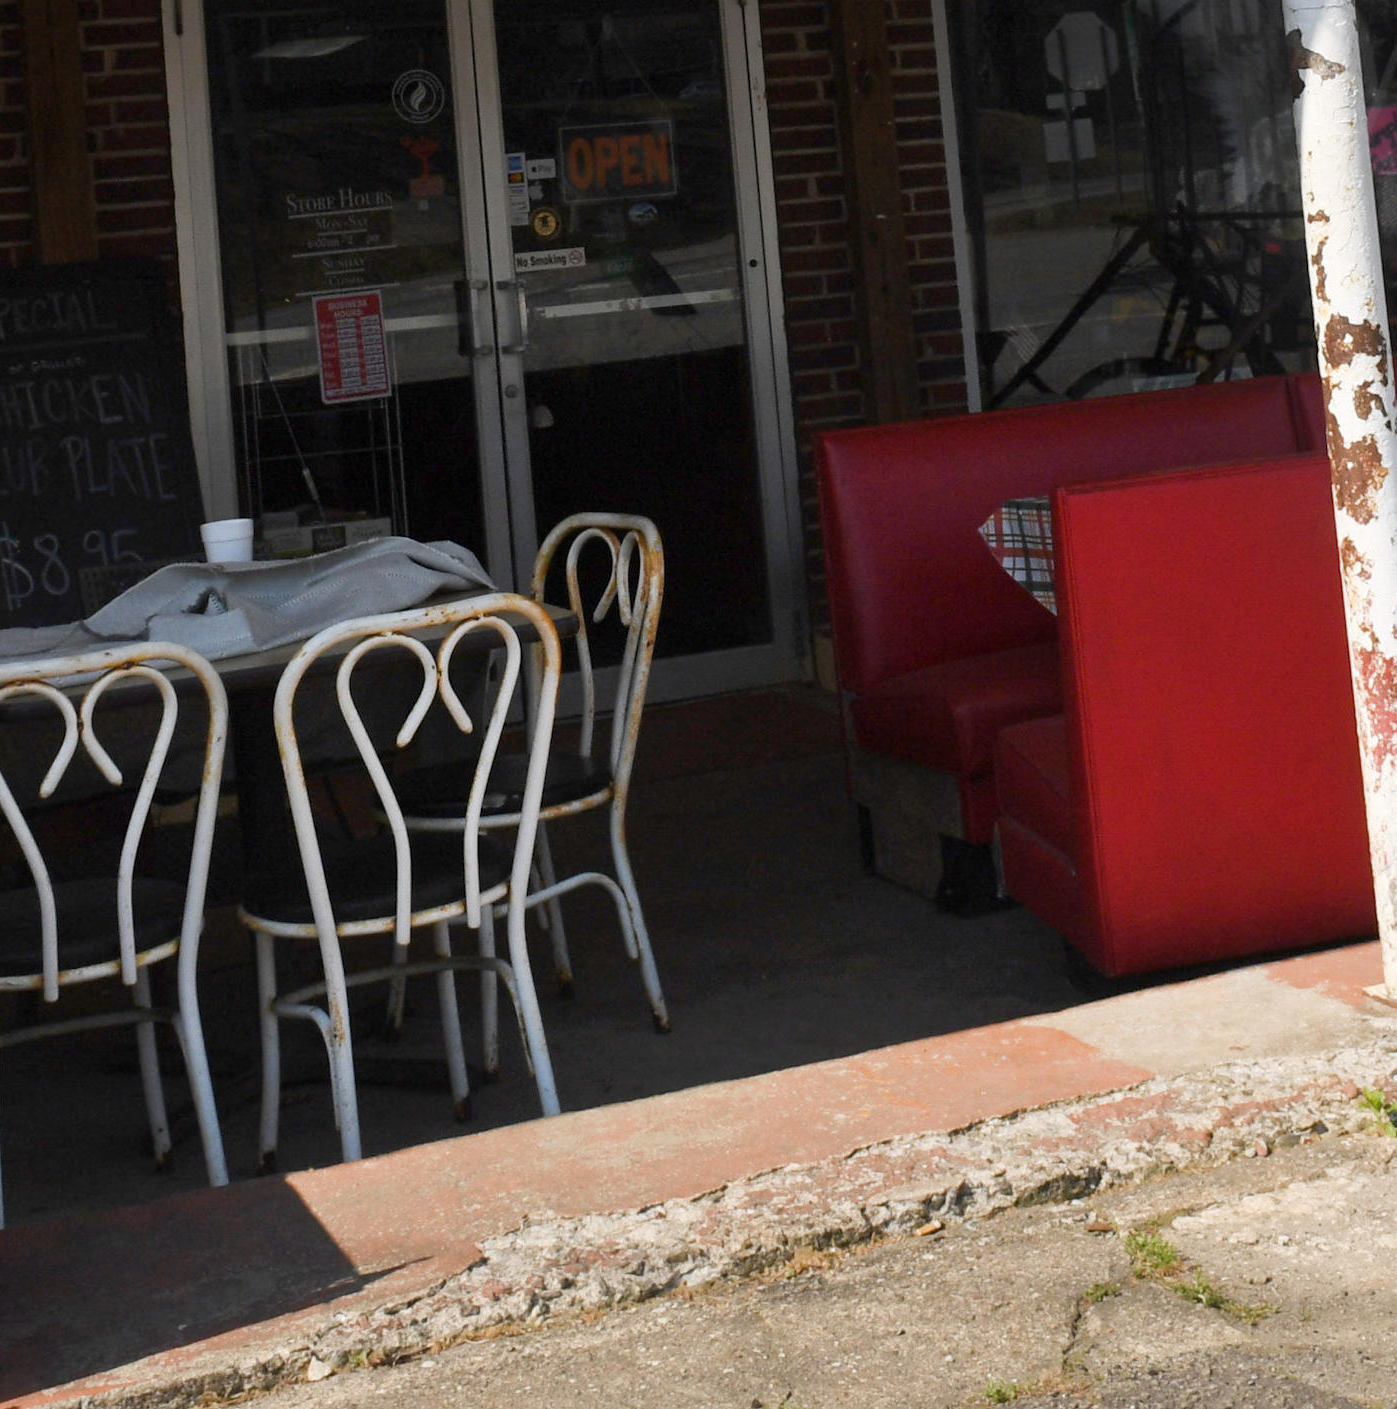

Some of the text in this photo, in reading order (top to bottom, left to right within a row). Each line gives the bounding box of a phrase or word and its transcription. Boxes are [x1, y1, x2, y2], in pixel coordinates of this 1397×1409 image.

[567, 133, 672, 191] OPEN
[516, 253, 567, 267] No Smoking
[60, 432, 178, 502] PLATE
